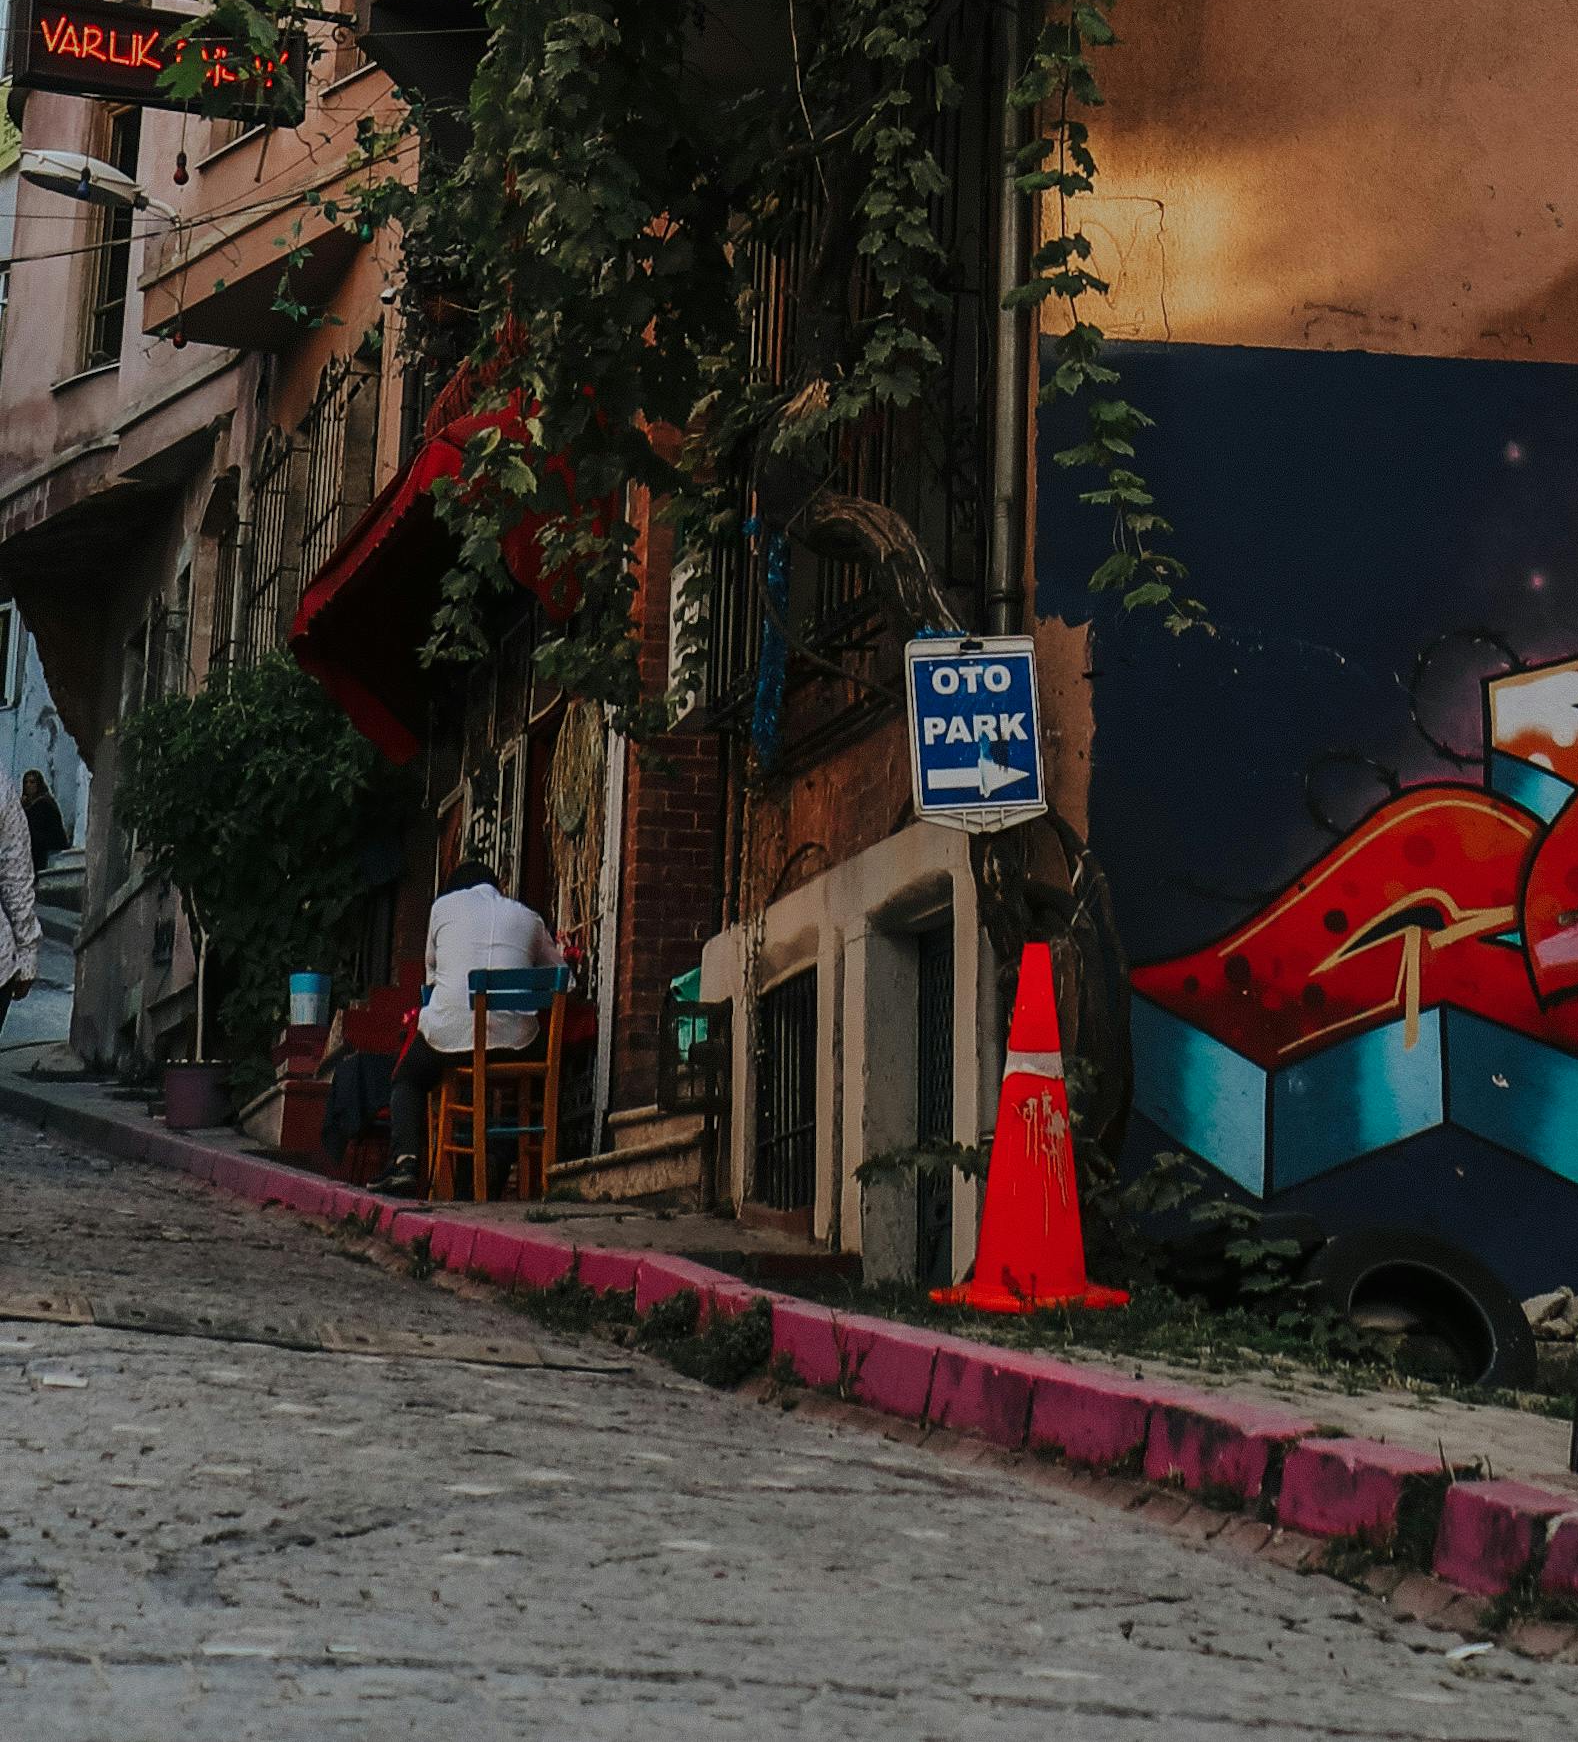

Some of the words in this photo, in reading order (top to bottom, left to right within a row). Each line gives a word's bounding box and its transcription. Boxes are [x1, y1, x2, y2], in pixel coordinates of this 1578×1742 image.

[40, 16, 162, 69] VARLIK
[931, 665, 1012, 695] OTO
[923, 713, 1029, 746] PARK
